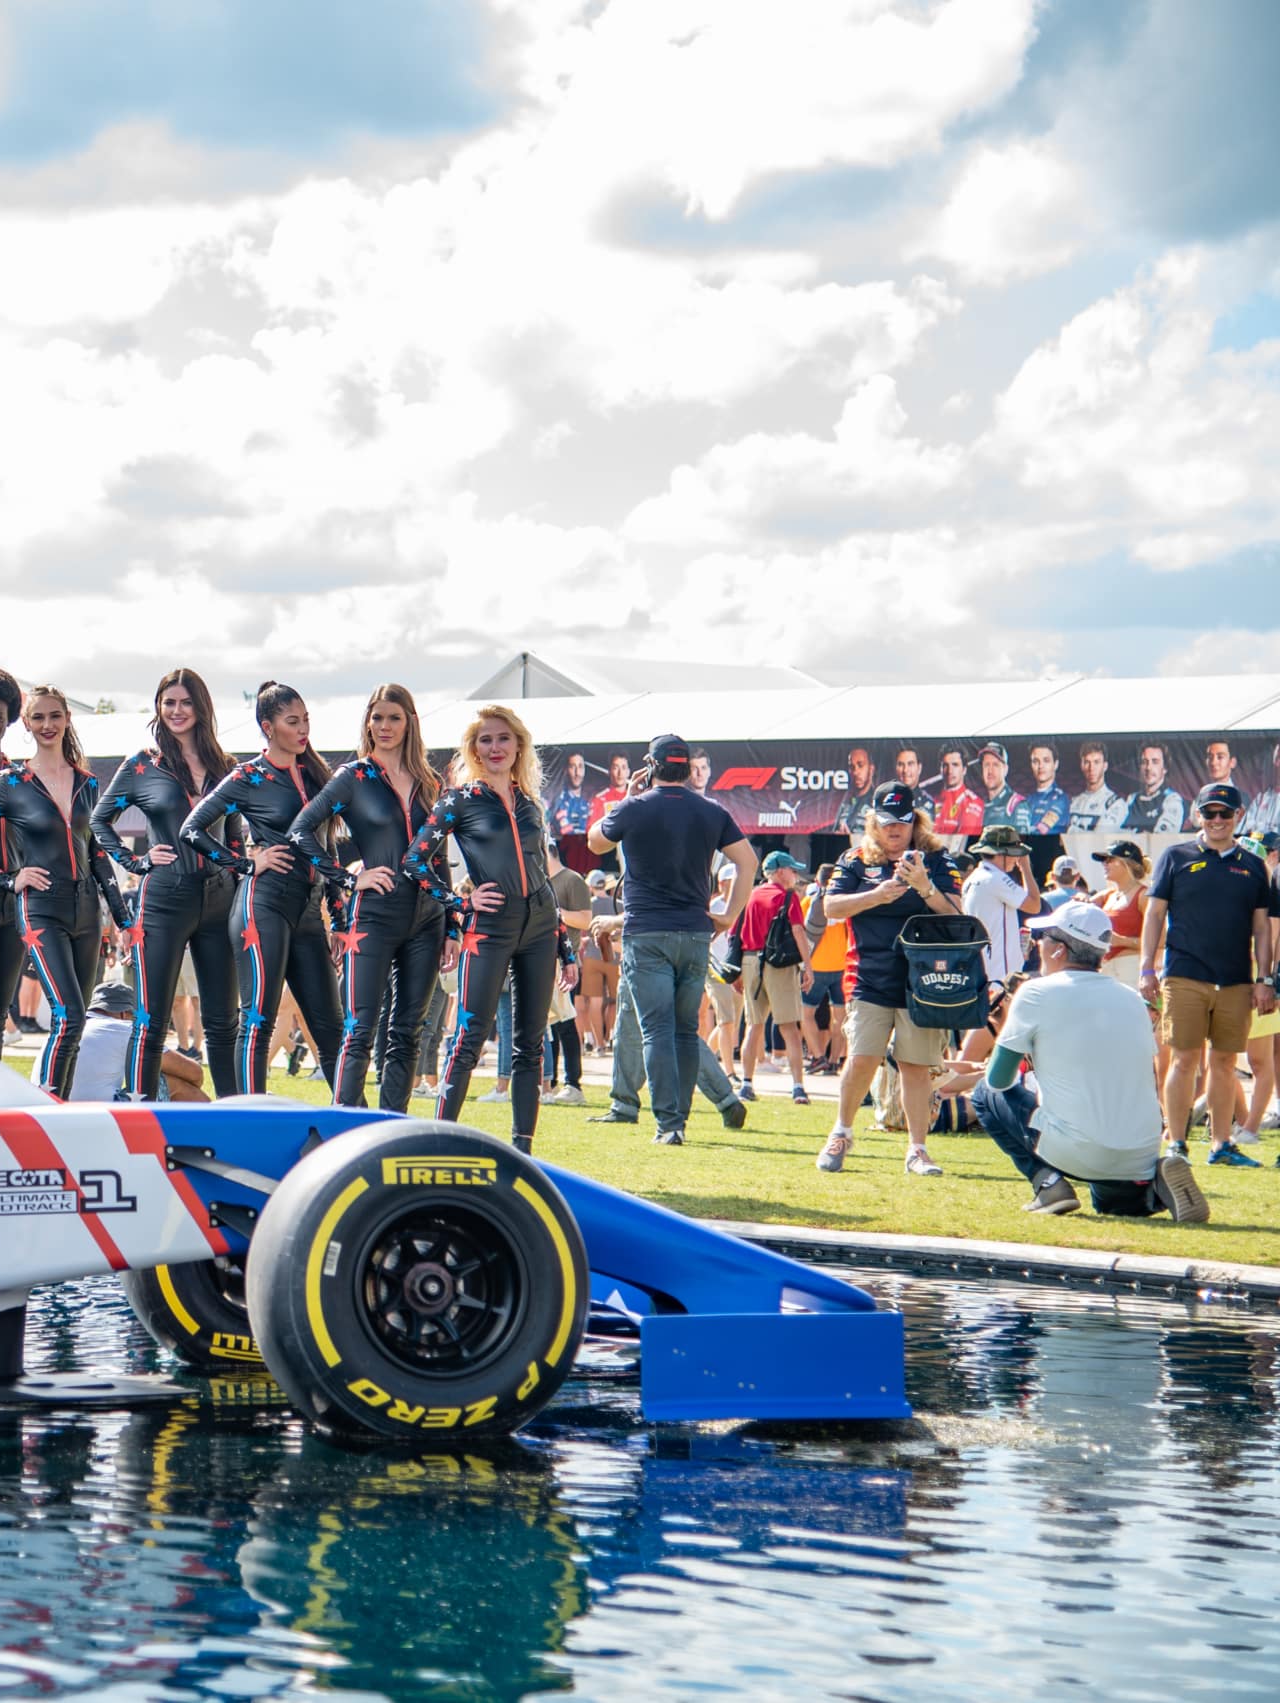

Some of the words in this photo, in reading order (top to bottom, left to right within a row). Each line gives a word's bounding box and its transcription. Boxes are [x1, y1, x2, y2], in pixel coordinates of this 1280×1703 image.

[780, 766, 849, 791] Store
[758, 812, 793, 827] PUMA
[921, 972, 969, 986] UDAPEST
[382, 1155, 497, 1185] PIRELLI
[79, 1169, 137, 1213] 1
[517, 1360, 540, 1401] P
[347, 1378, 498, 1428] ZERO
